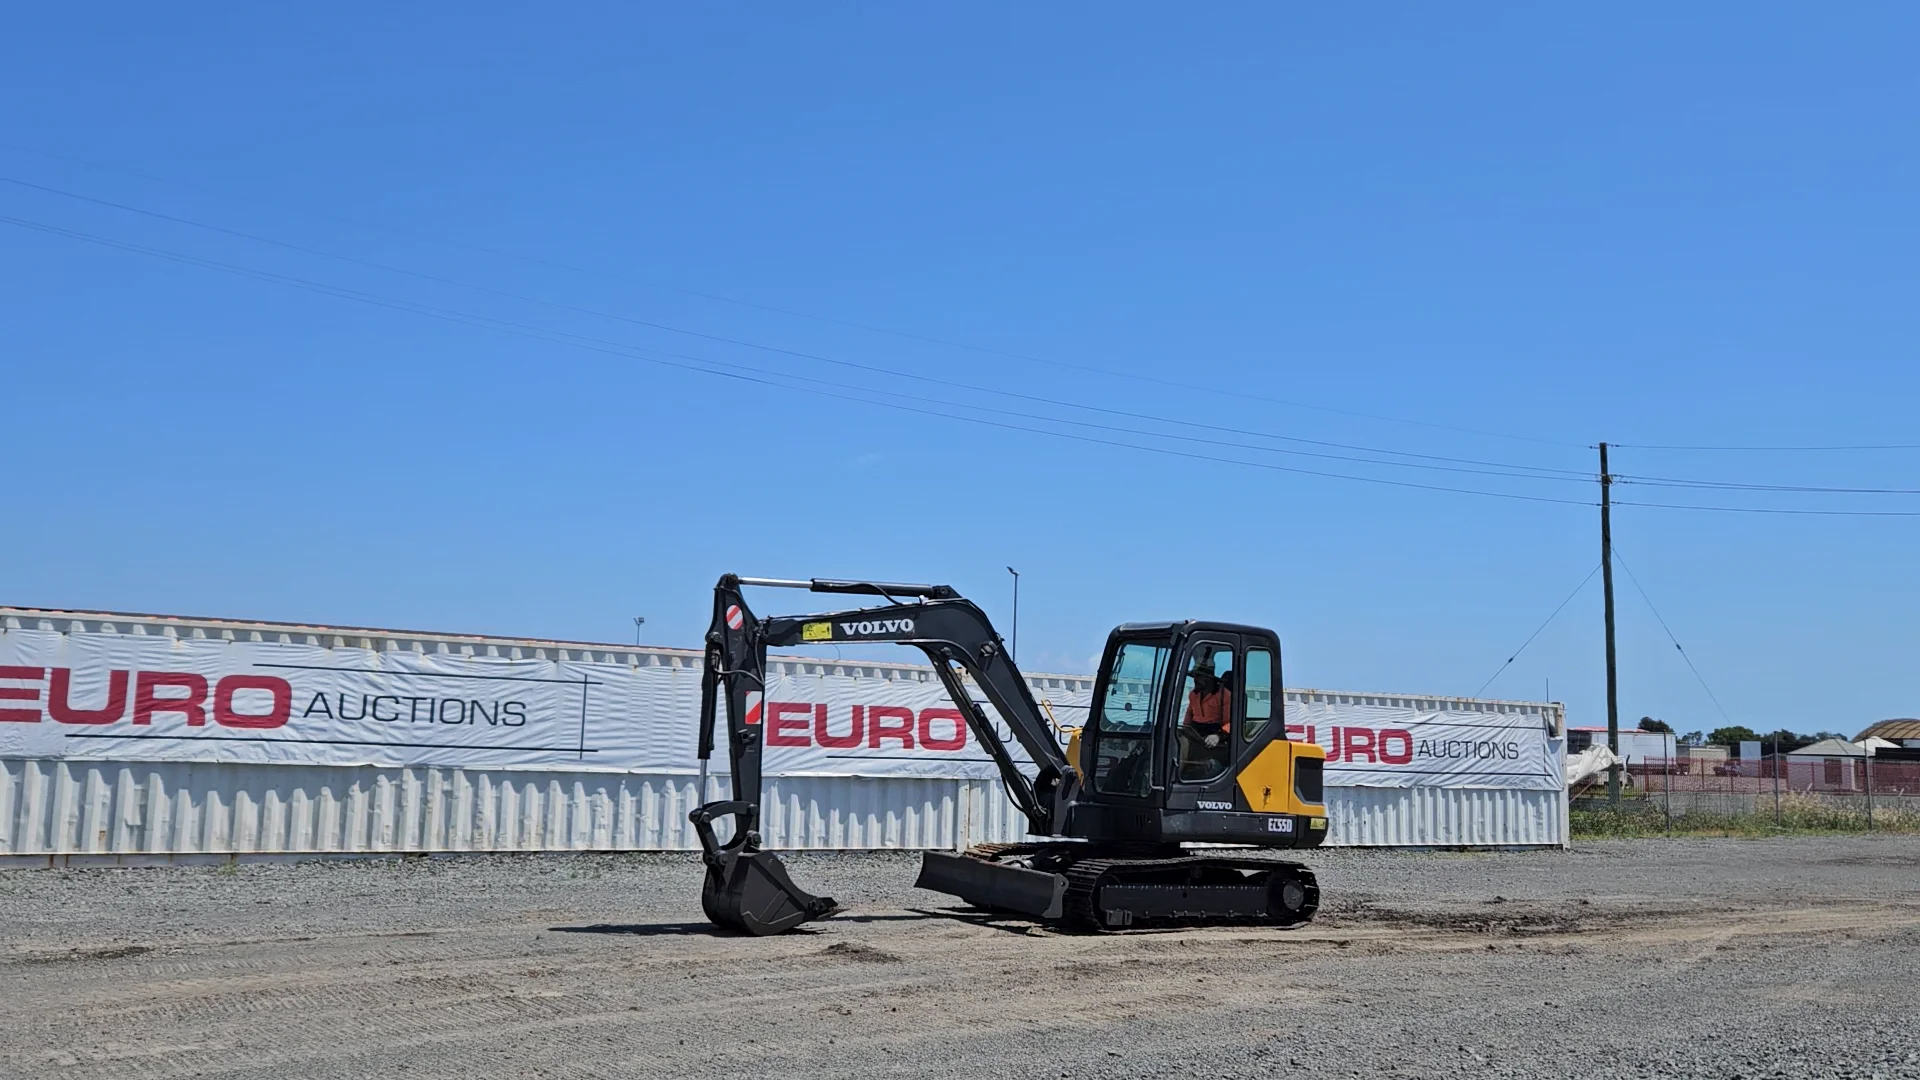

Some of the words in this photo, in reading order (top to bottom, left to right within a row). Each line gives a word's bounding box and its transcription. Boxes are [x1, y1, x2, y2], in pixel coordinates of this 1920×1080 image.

[840, 619, 915, 636] VOLVO
[302, 692, 527, 727] AUCTIONS
[766, 702, 967, 751] EURO
[1418, 739, 1519, 760] AUCTIONS
[1197, 800, 1232, 810] VOLVO
